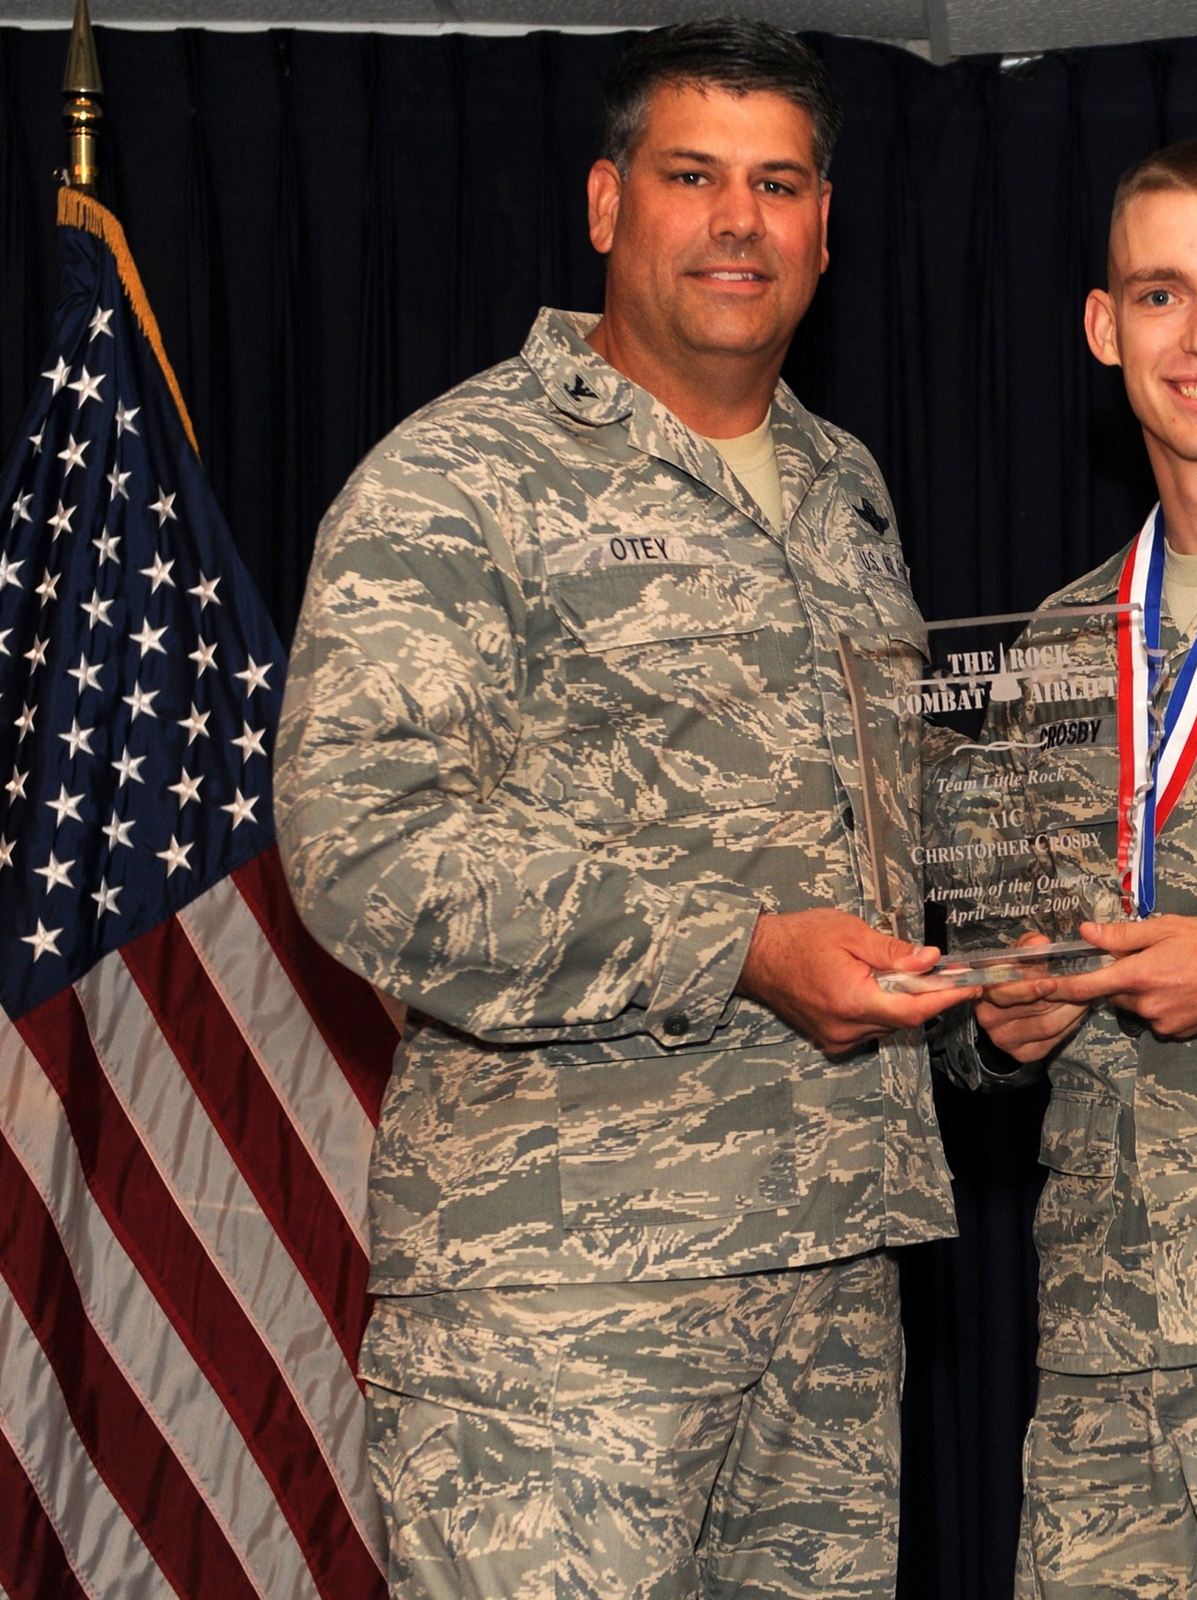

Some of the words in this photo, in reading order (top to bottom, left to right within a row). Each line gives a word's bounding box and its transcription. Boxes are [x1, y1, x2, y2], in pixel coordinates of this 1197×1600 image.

[610, 537, 668, 561] OTEY
[858, 550, 883, 573] U.S.
[947, 650, 995, 675] THE
[1008, 644, 1072, 669] ROCK
[892, 688, 986, 716] COMBAT
[1030, 676, 1119, 704] AIRLIFT
[1040, 719, 1102, 752] CROSBY
[937, 778, 977, 794] Team
[982, 772, 1023, 789] Little
[1027, 766, 1066, 785] Rock
[986, 808, 1025, 831] A1C
[911, 839, 1031, 866] CHRISTOPHER
[1035, 831, 1102, 852] CROSBY
[924, 886, 983, 903] Airman
[988, 879, 1007, 899] of
[1008, 878, 1032, 894] the
[945, 904, 987, 927] April
[1001, 903, 1040, 918] June
[1044, 895, 1080, 913] 2009
